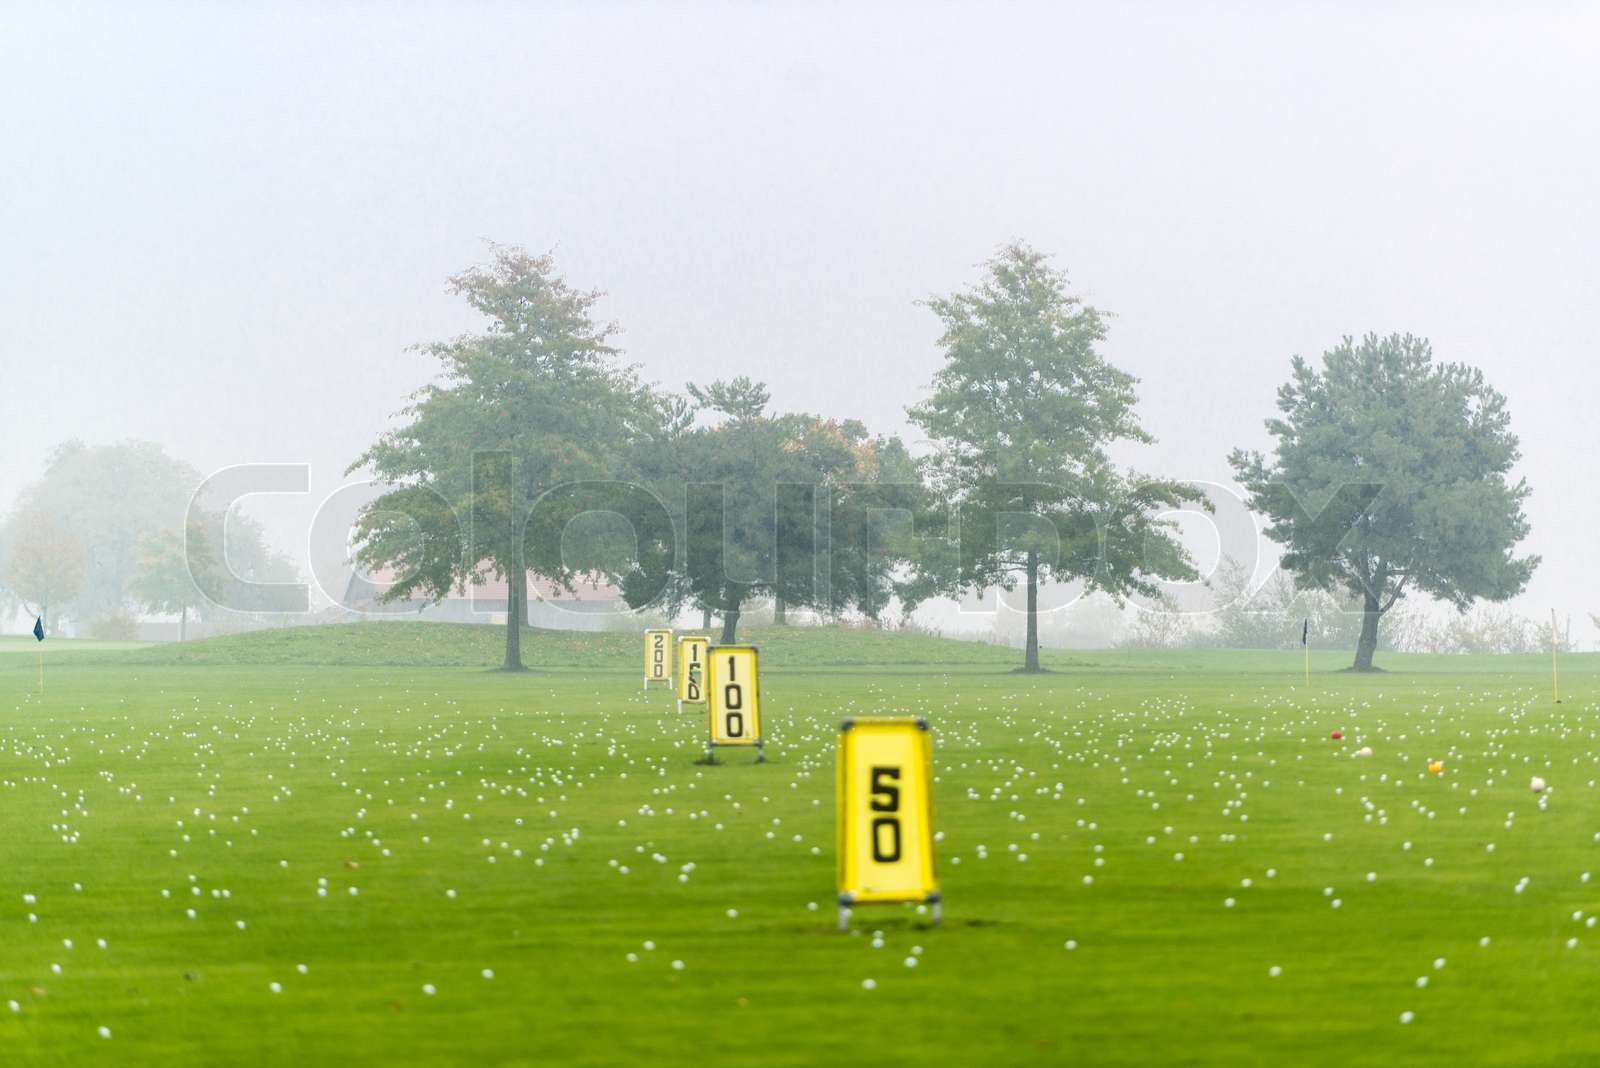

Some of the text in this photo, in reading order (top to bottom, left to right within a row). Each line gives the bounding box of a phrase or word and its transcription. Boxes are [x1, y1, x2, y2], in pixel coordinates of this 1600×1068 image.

[654, 635, 664, 678] 200
[725, 656, 743, 737] 100
[871, 766, 901, 862] 50
